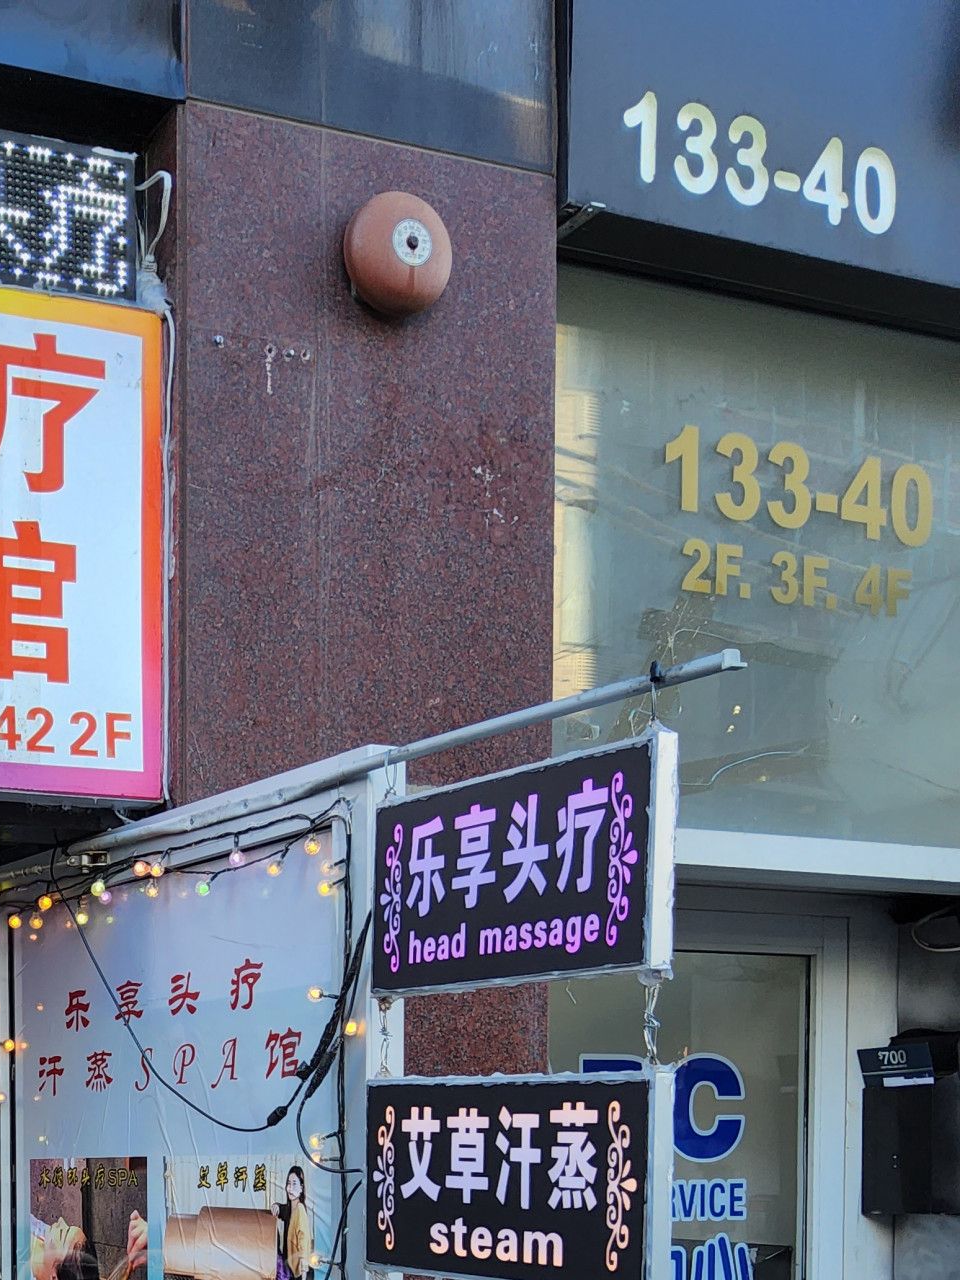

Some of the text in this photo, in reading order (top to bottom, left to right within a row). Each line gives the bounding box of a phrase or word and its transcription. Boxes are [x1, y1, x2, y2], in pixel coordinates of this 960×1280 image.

[624, 91, 896, 235] 133-40
[665, 424, 933, 548] 133-40
[682, 539, 750, 598] 2F.
[855, 564, 912, 617] 4F
[70, 711, 133, 759] 2F
[405, 777, 610, 917] 乐享头疗
[409, 913, 601, 964] head massage
[65, 957, 264, 1032] 乐享头疗
[878, 1050, 906, 1065] $700
[197, 1161, 267, 1192] 艾草汗蒸
[400, 1102, 598, 1212] 艾草汗蒸
[429, 1218, 564, 1268] steam
